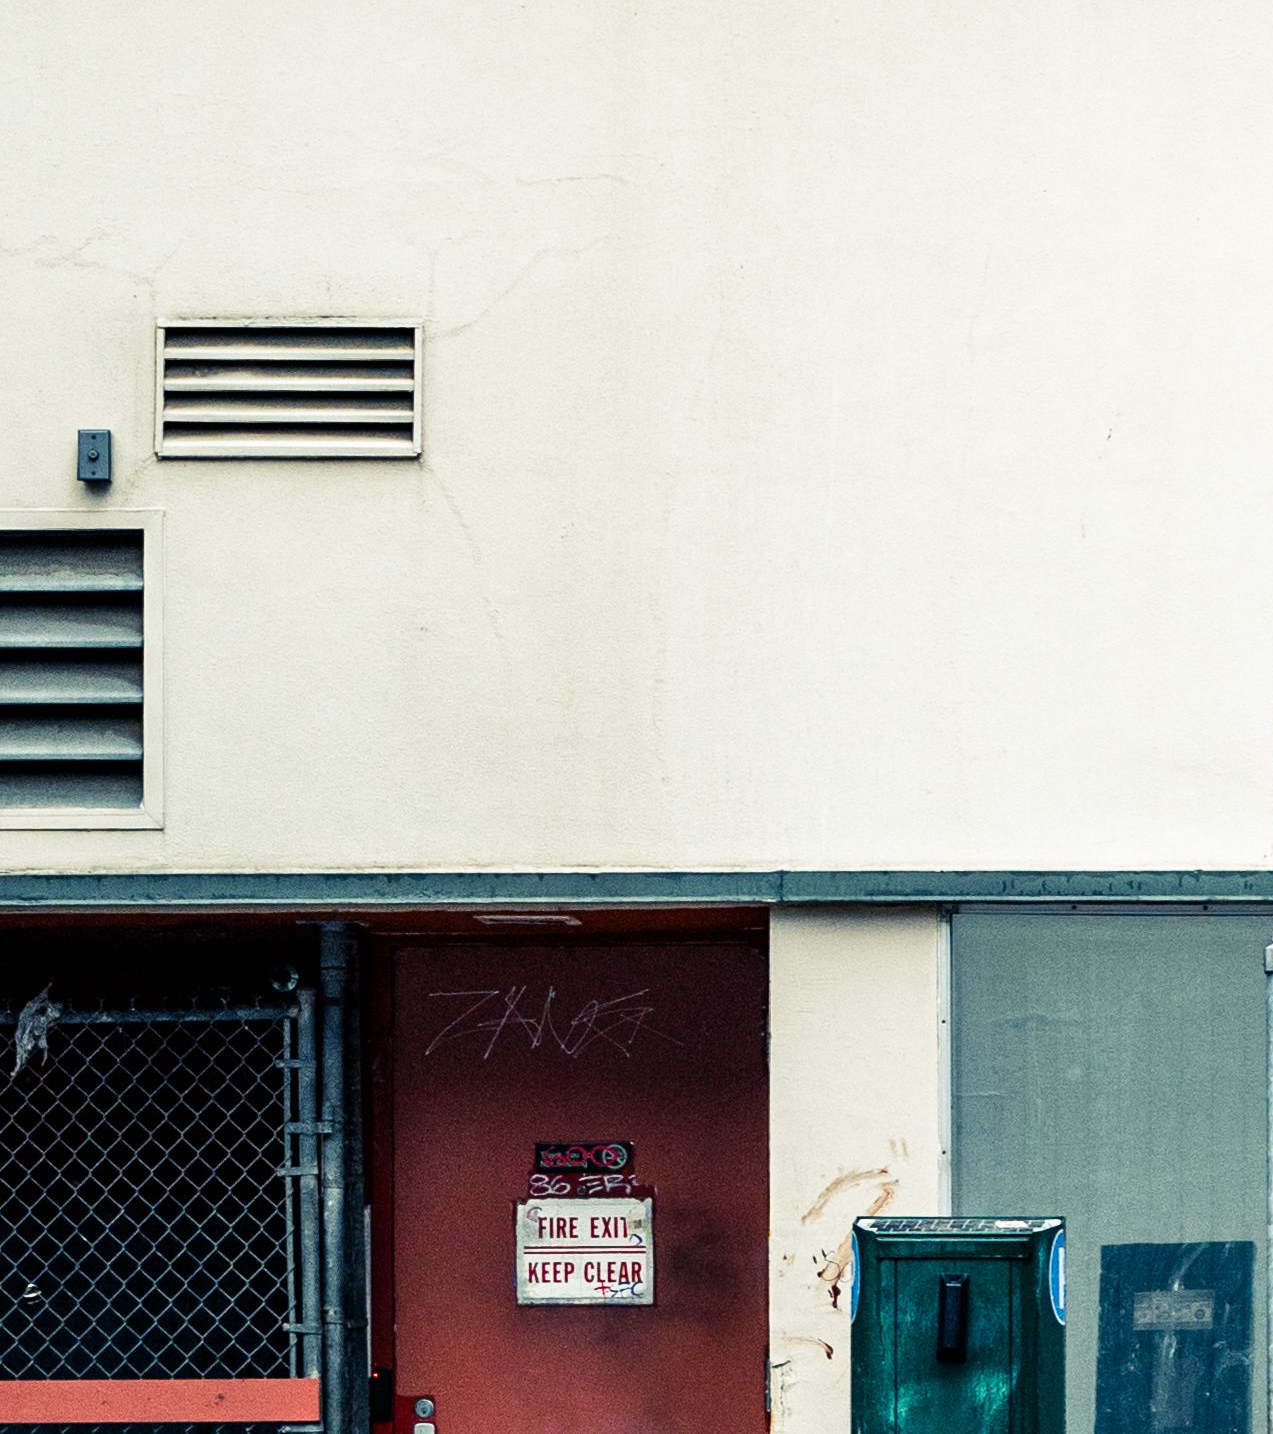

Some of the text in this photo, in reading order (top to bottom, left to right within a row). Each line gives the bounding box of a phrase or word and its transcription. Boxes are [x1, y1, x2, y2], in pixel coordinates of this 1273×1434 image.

[537, 1216, 630, 1239] FIRE EXIT
[528, 1261, 643, 1284] KEEP CLEAR
